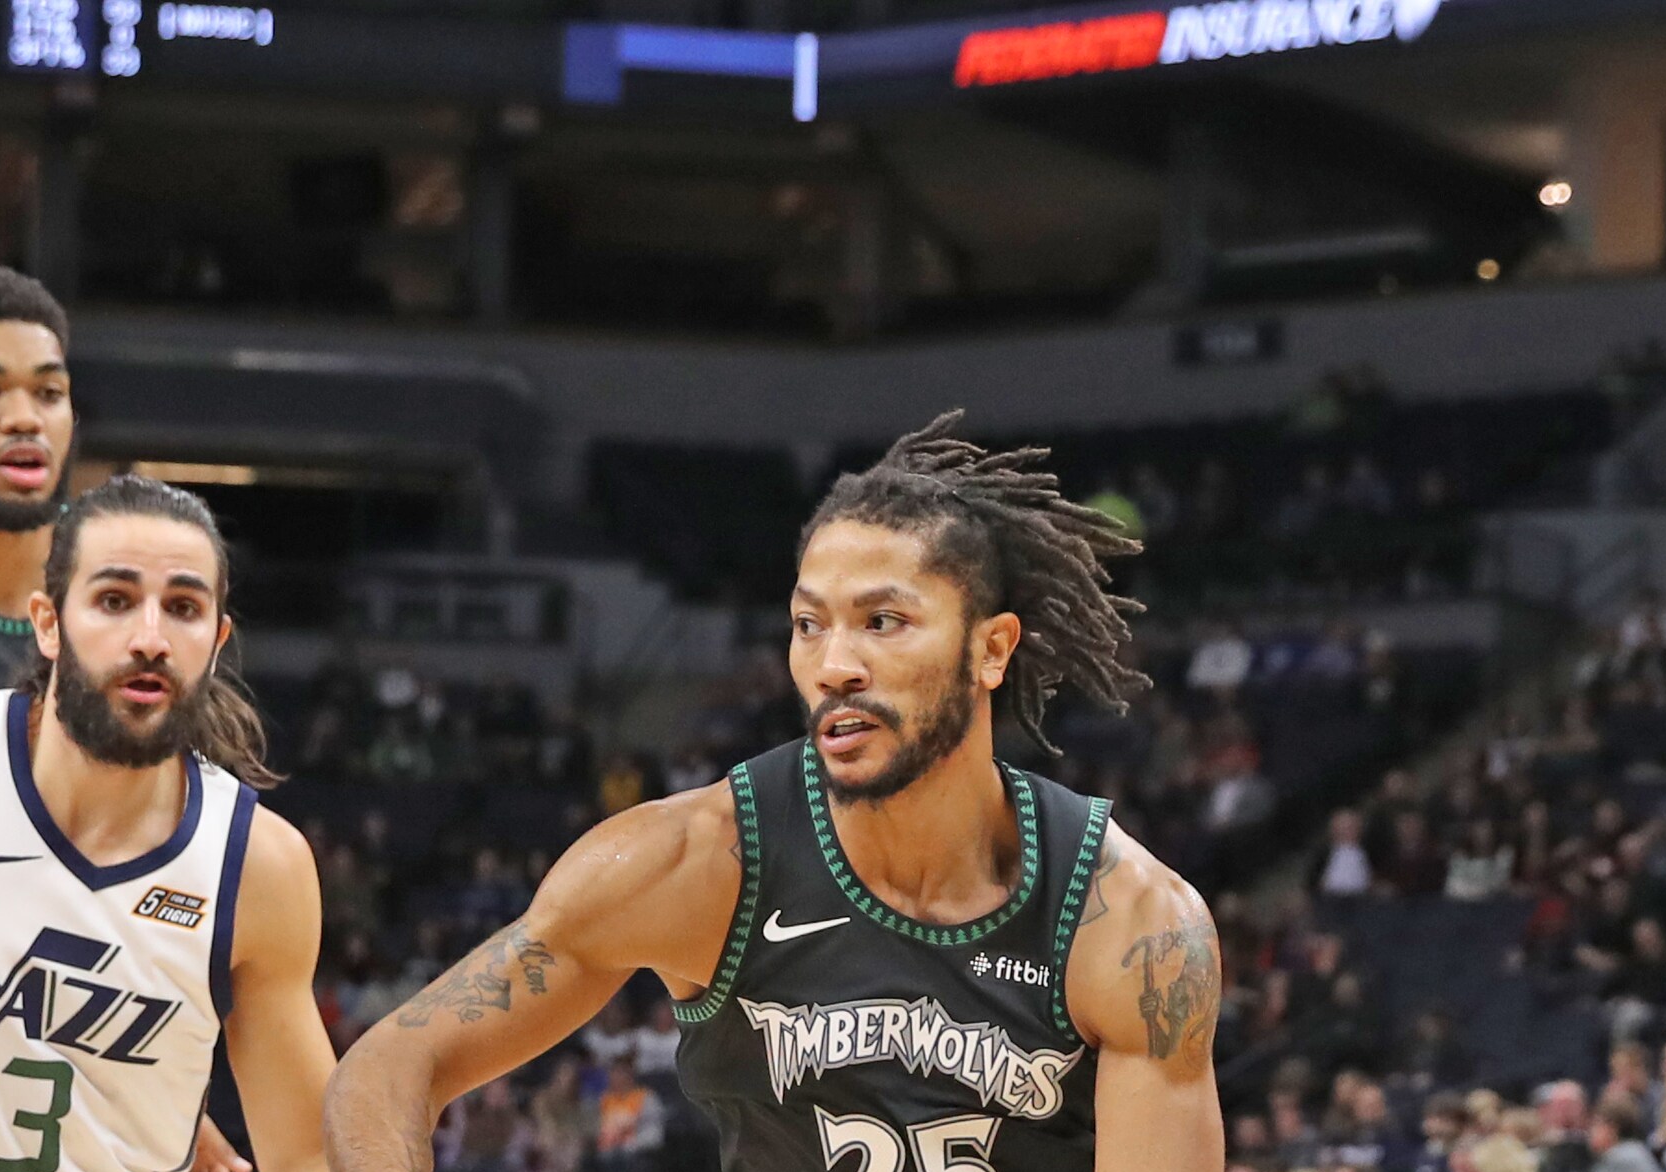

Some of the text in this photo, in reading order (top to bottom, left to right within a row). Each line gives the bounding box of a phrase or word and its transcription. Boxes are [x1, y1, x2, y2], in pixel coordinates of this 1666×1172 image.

[138, 888, 167, 916] 5
[157, 906, 201, 926] FIGHT
[995, 956, 1050, 987] fitbit
[737, 996, 1085, 1120] TIMBERWOLVES
